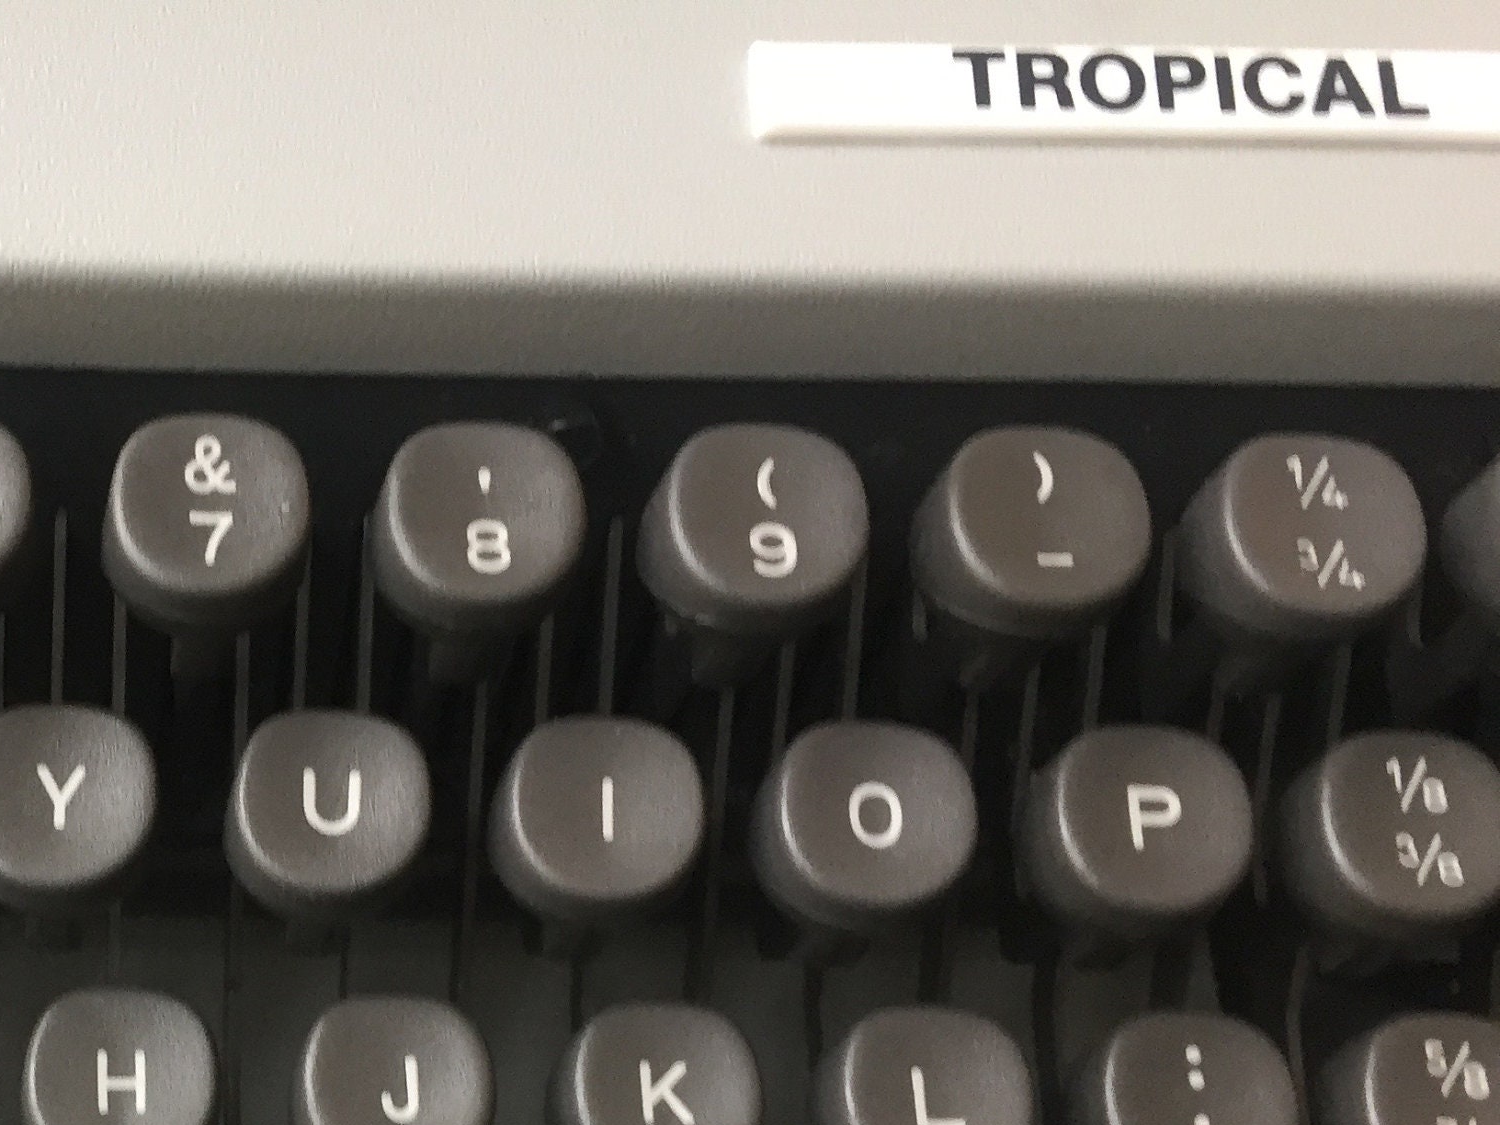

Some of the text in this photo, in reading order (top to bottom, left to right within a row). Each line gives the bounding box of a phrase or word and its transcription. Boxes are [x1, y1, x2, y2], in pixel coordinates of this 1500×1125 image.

[952, 48, 1430, 118] TROPICAL
[185, 434, 237, 495] &
[189, 509, 234, 567] 7
[467, 518, 512, 575] 8
[749, 521, 798, 578] 9
[36, 763, 86, 831] Y
[303, 767, 362, 836] U
[601, 776, 615, 843] I
[849, 781, 903, 849] O
[1127, 784, 1182, 851] P
[97, 1048, 147, 1116] H
[380, 1055, 420, 1125] J
